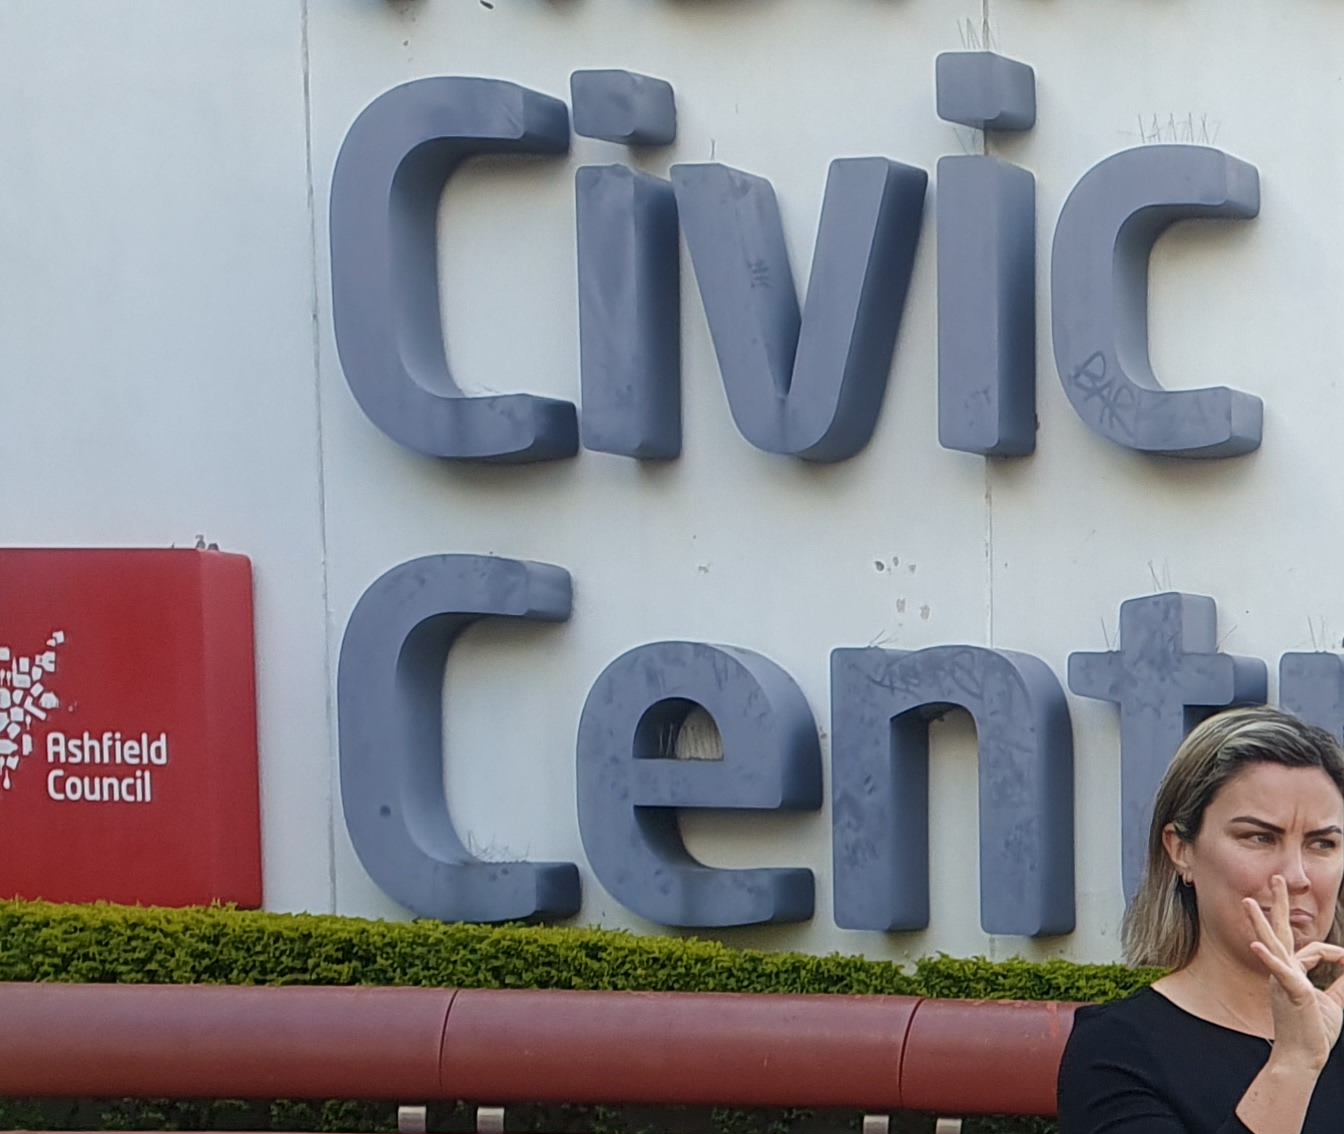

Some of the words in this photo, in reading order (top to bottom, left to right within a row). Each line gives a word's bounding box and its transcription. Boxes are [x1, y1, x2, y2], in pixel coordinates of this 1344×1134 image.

[330, 51, 1263, 463] Civic
[47, 731, 167, 765] Ashfield
[47, 769, 152, 802] Council
